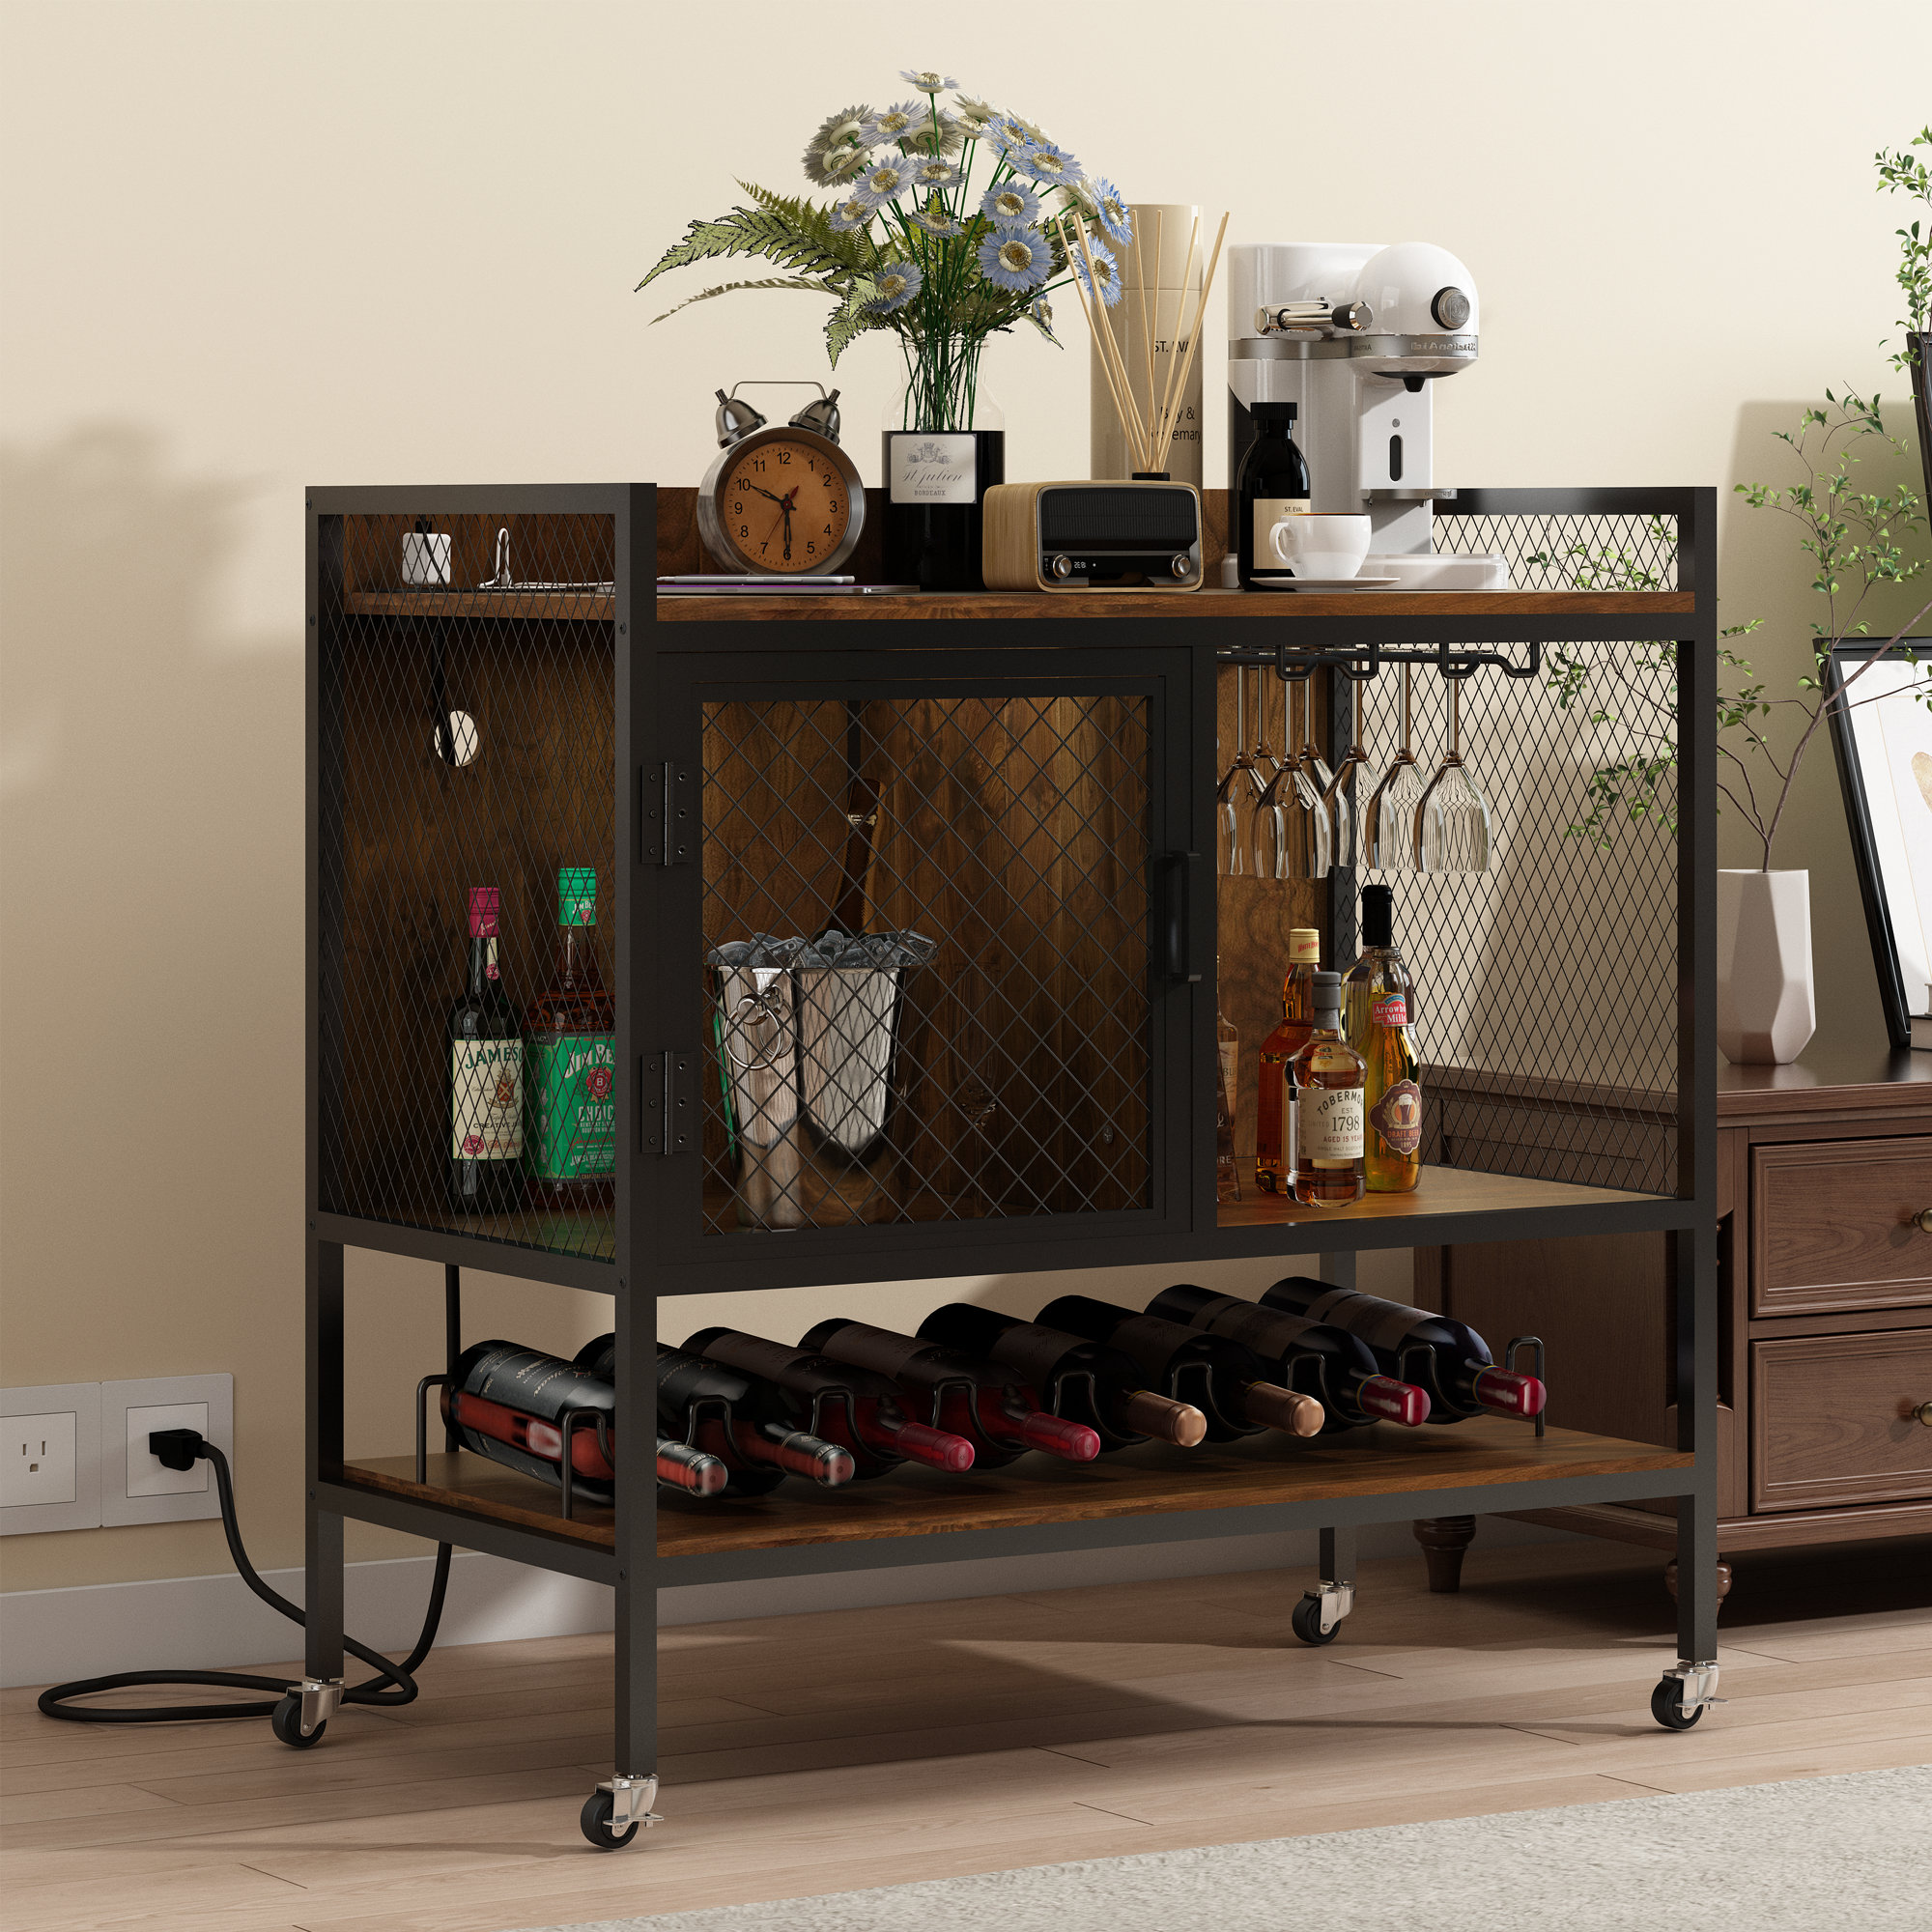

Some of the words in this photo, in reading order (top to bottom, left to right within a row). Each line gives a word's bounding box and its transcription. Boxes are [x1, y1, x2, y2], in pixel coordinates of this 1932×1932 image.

[1186, 406, 1195, 420] &
[777, 451, 791, 465] 12
[753, 459, 766, 472] 11
[808, 459, 814, 472] 1
[737, 478, 751, 492] 10
[823, 473, 832, 487] 2
[734, 501, 743, 515] 9
[829, 500, 838, 513] 3
[740, 525, 749, 538] 8
[823, 524, 832, 536] 4
[760, 542, 769, 554] 7
[782, 548, 792, 560] 6
[807, 541, 815, 554] 5
[1331, 1115, 1360, 1132] 1798
